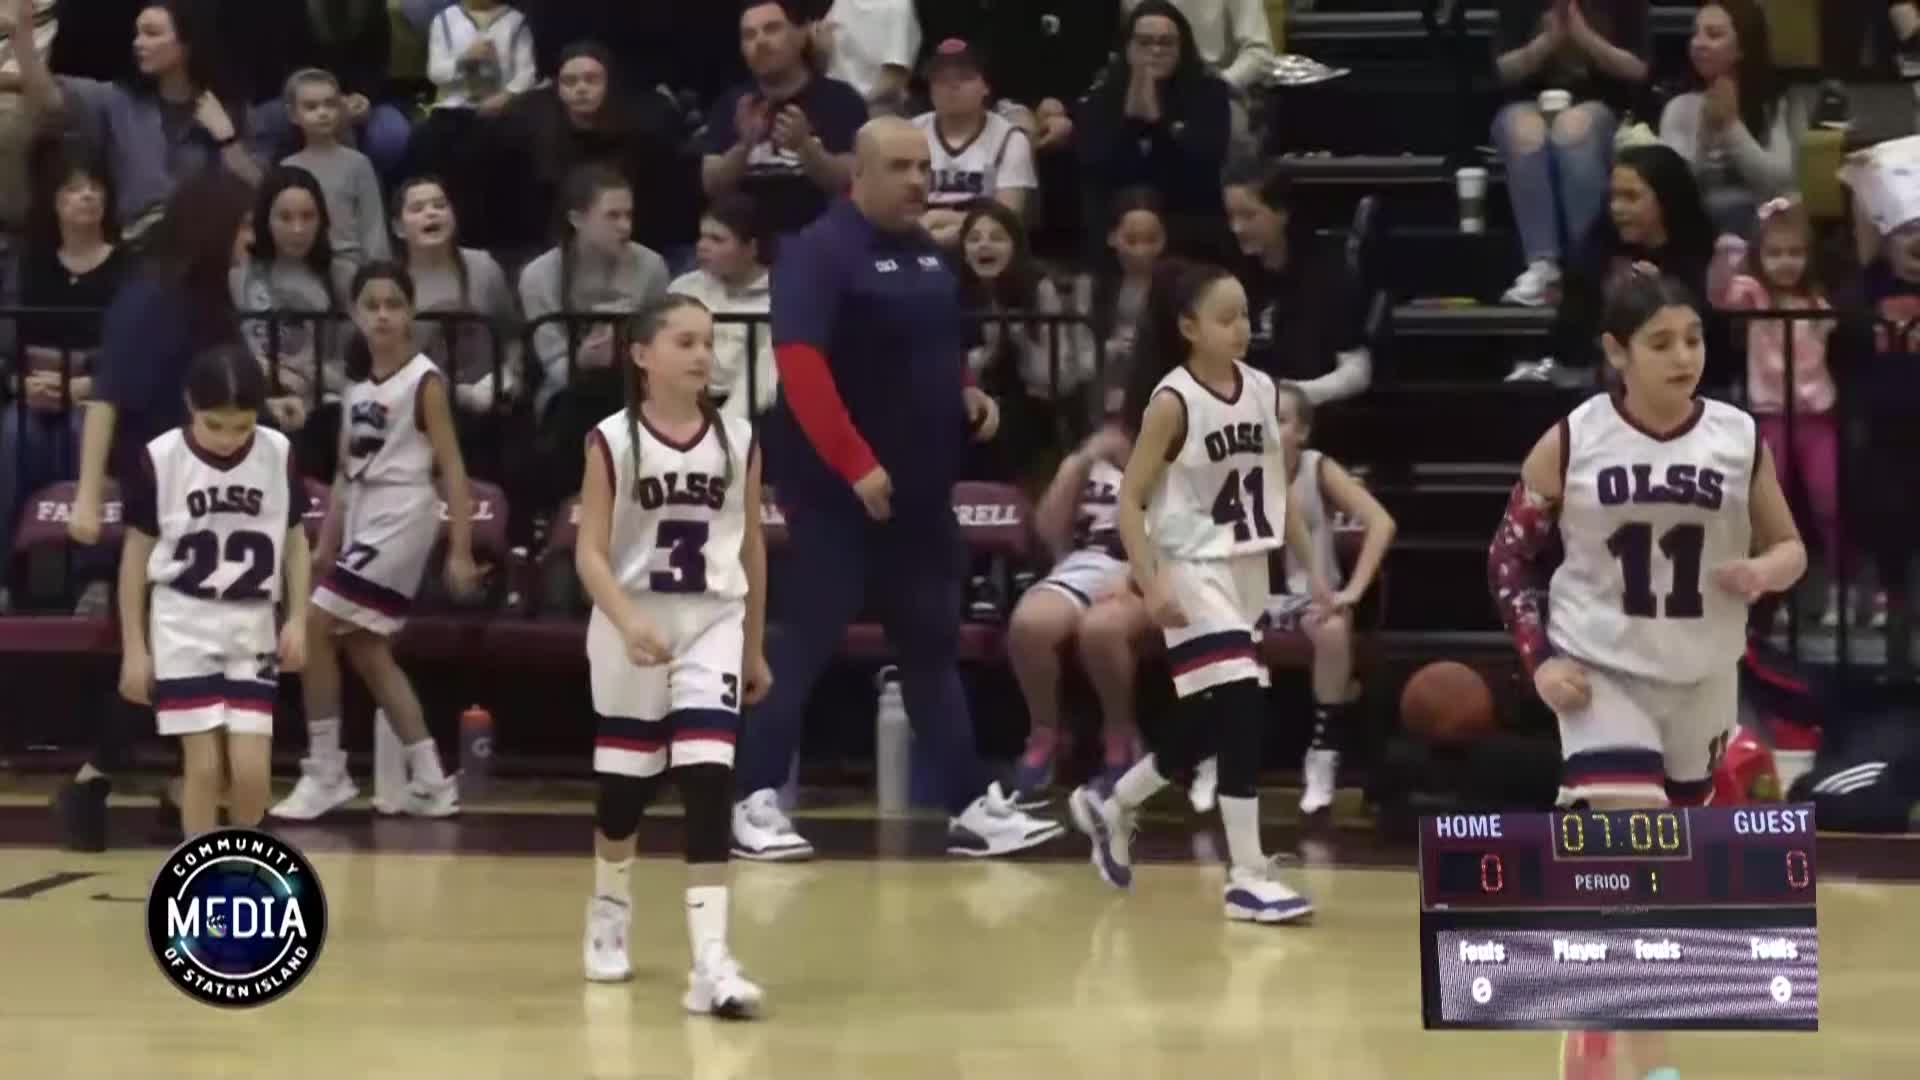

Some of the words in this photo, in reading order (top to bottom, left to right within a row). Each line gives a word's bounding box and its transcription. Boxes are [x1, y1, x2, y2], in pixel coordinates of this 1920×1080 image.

[186, 485, 263, 517] OLSS
[638, 472, 727, 510] OLSS
[1211, 466, 1274, 541] 41
[1597, 464, 1724, 511] OLSS
[953, 504, 1020, 526] RELL
[171, 529, 274, 601] 22
[651, 519, 709, 592] 3
[1606, 521, 1705, 619] 11
[720, 672, 738, 708] 3
